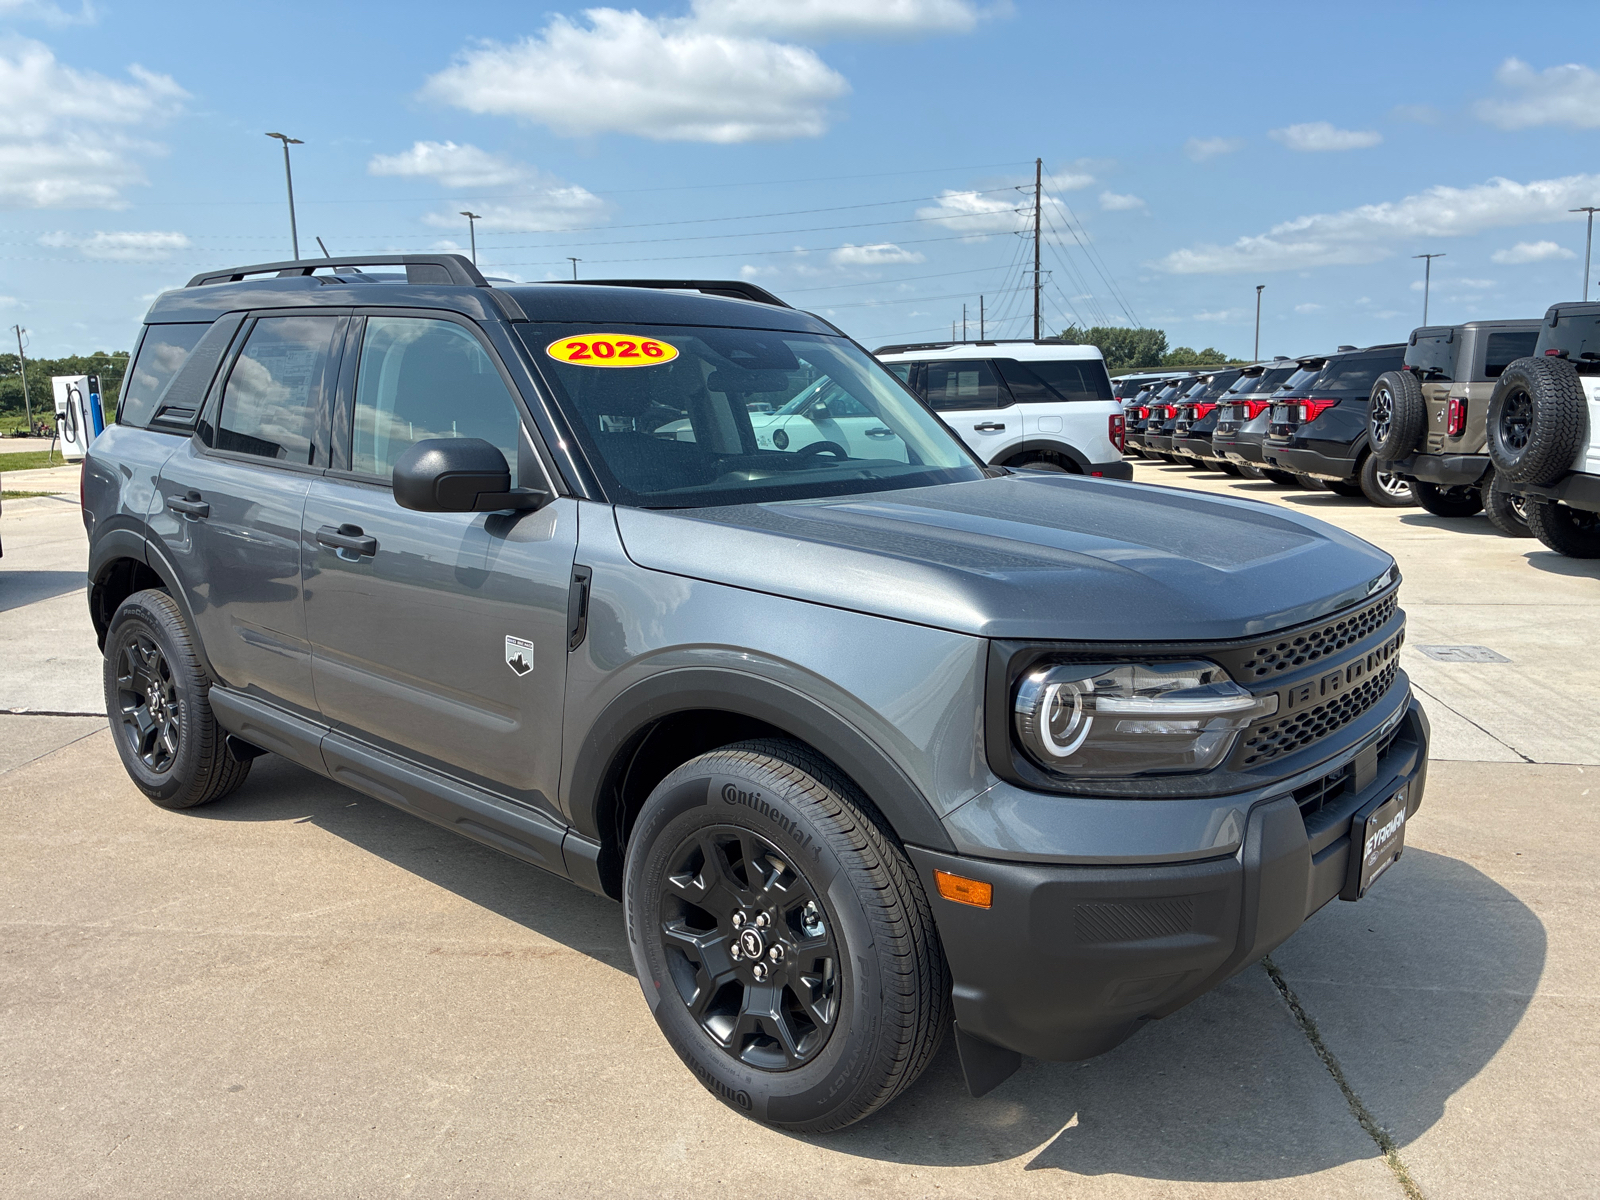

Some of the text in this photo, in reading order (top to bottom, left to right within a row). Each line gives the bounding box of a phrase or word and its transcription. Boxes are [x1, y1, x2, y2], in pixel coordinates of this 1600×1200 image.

[565, 340, 665, 361] 2026
[1288, 627, 1405, 709] BRONCO
[721, 782, 814, 850] Continental
